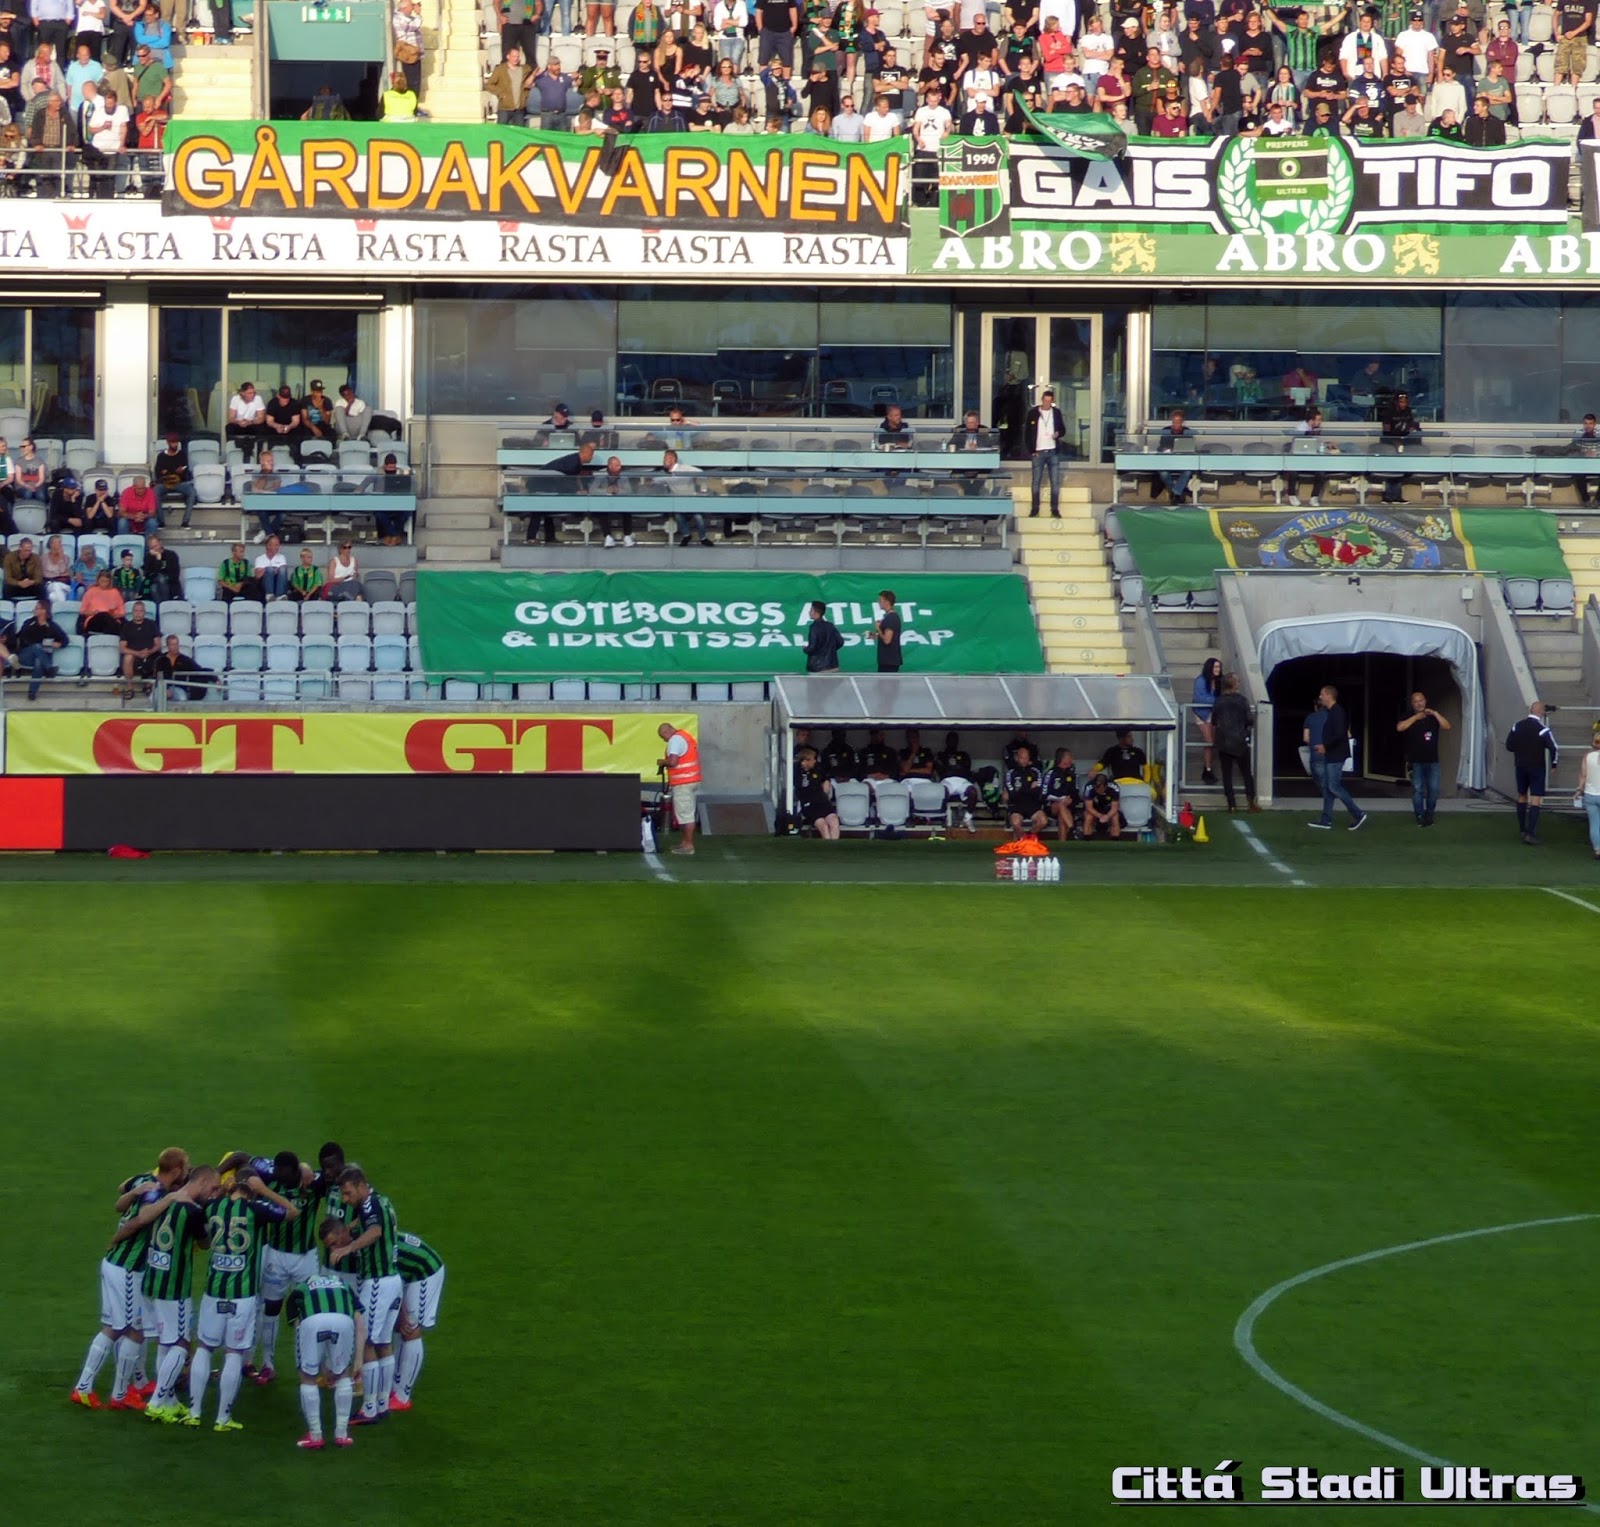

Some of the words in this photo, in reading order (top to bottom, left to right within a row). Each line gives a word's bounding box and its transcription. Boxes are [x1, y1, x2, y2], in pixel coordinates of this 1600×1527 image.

[172, 125, 900, 224] GÅRDAKVARNEN
[965, 153, 997, 165] 1996
[1017, 158, 1210, 208] GAIS
[1363, 158, 1551, 207] TIFO
[1276, 187, 1308, 195] ULTRAS
[67, 231, 183, 260] RASTA
[212, 232, 326, 262] RASTA
[357, 233, 470, 263] RASTA
[500, 234, 612, 263] RASTA
[642, 236, 754, 265] RASTA
[784, 236, 896, 266] RASTA
[502, 630, 538, 648] &
[92, 718, 304, 774] GT
[404, 718, 614, 774] GT
[208, 1215, 251, 1253] 25
[216, 1255, 244, 1267] BDO
